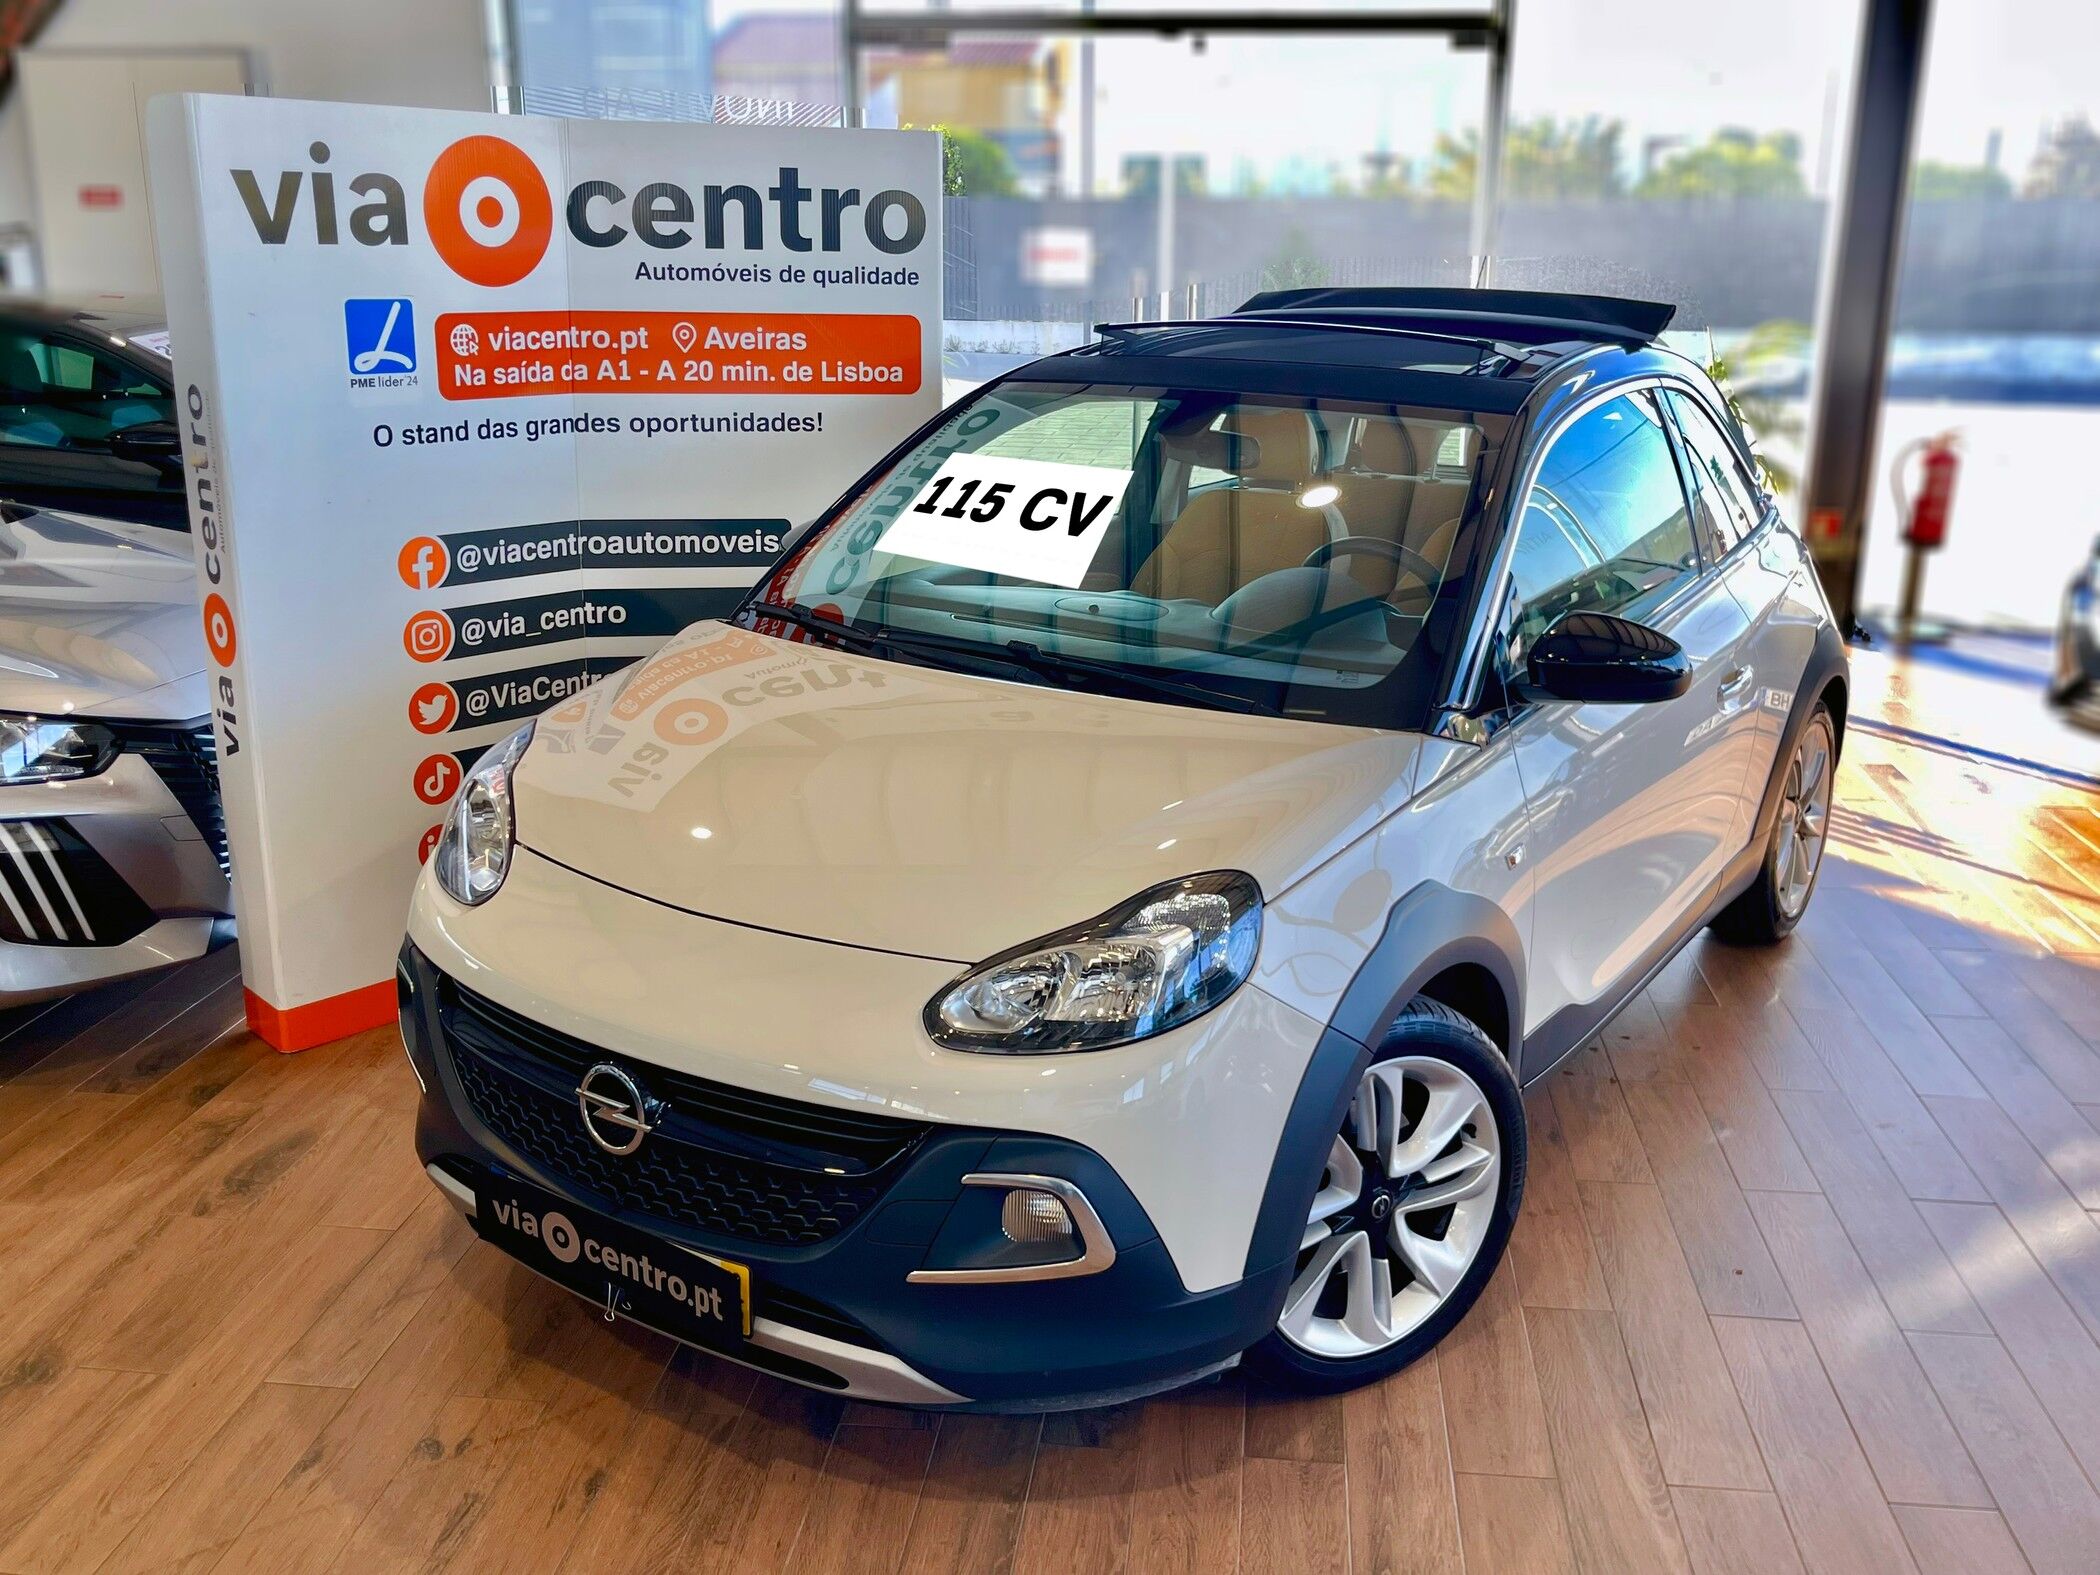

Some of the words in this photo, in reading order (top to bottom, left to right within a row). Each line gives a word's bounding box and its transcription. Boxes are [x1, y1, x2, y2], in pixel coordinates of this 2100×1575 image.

[229, 140, 410, 246] via
[565, 167, 927, 257] centro
[635, 261, 772, 283] Automóveis
[779, 264, 807, 284] de
[812, 266, 920, 289] qualidade
[488, 325, 649, 355] viacentro.pt
[703, 326, 808, 351] Aveiras
[350, 378, 376, 389] PME
[454, 363, 486, 387] Na
[493, 360, 554, 385] saída
[561, 359, 588, 381] da
[596, 359, 632, 382] A1
[656, 359, 677, 382] A
[683, 359, 714, 382] 20
[722, 359, 776, 382] min.
[782, 361, 813, 383] de
[821, 361, 904, 383] Lisboa
[373, 424, 394, 448] O
[401, 420, 469, 446] stand
[477, 418, 518, 440] das
[526, 413, 621, 442] grandes
[629, 412, 823, 438] oportunidades!
[457, 529, 780, 573] @viacentroautomoveis
[461, 601, 627, 646] @via_centro
[466, 671, 612, 717] @ViaCentr
[491, 1198, 539, 1239] via
[583, 1239, 725, 1322] centro.pt
